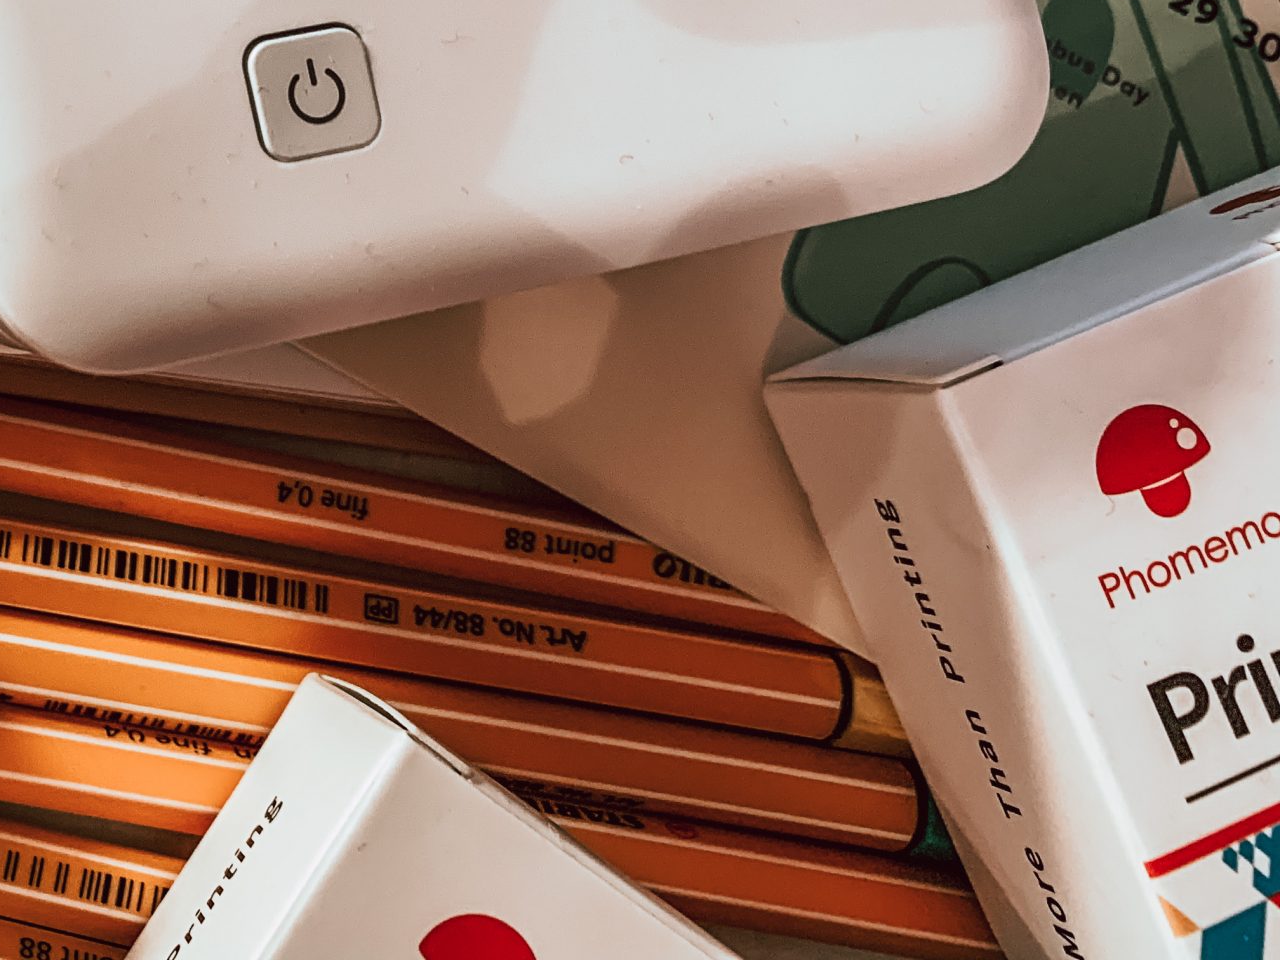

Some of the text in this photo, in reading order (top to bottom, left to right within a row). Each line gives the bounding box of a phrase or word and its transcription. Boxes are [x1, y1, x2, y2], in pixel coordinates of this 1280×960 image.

[1233, 18, 1280, 63] 30
[1102, 65, 1150, 107] Day
[277, 480, 314, 508] 0,4
[321, 489, 369, 521] fine
[504, 526, 536, 553] 88
[545, 533, 615, 564] point
[1098, 512, 1280, 608] Phomemo
[874, 498, 966, 685] Printing
[413, 605, 486, 636] 88/44
[493, 615, 536, 645] No.
[1146, 632, 1280, 765] Pri
[965, 709, 1023, 820] Than
